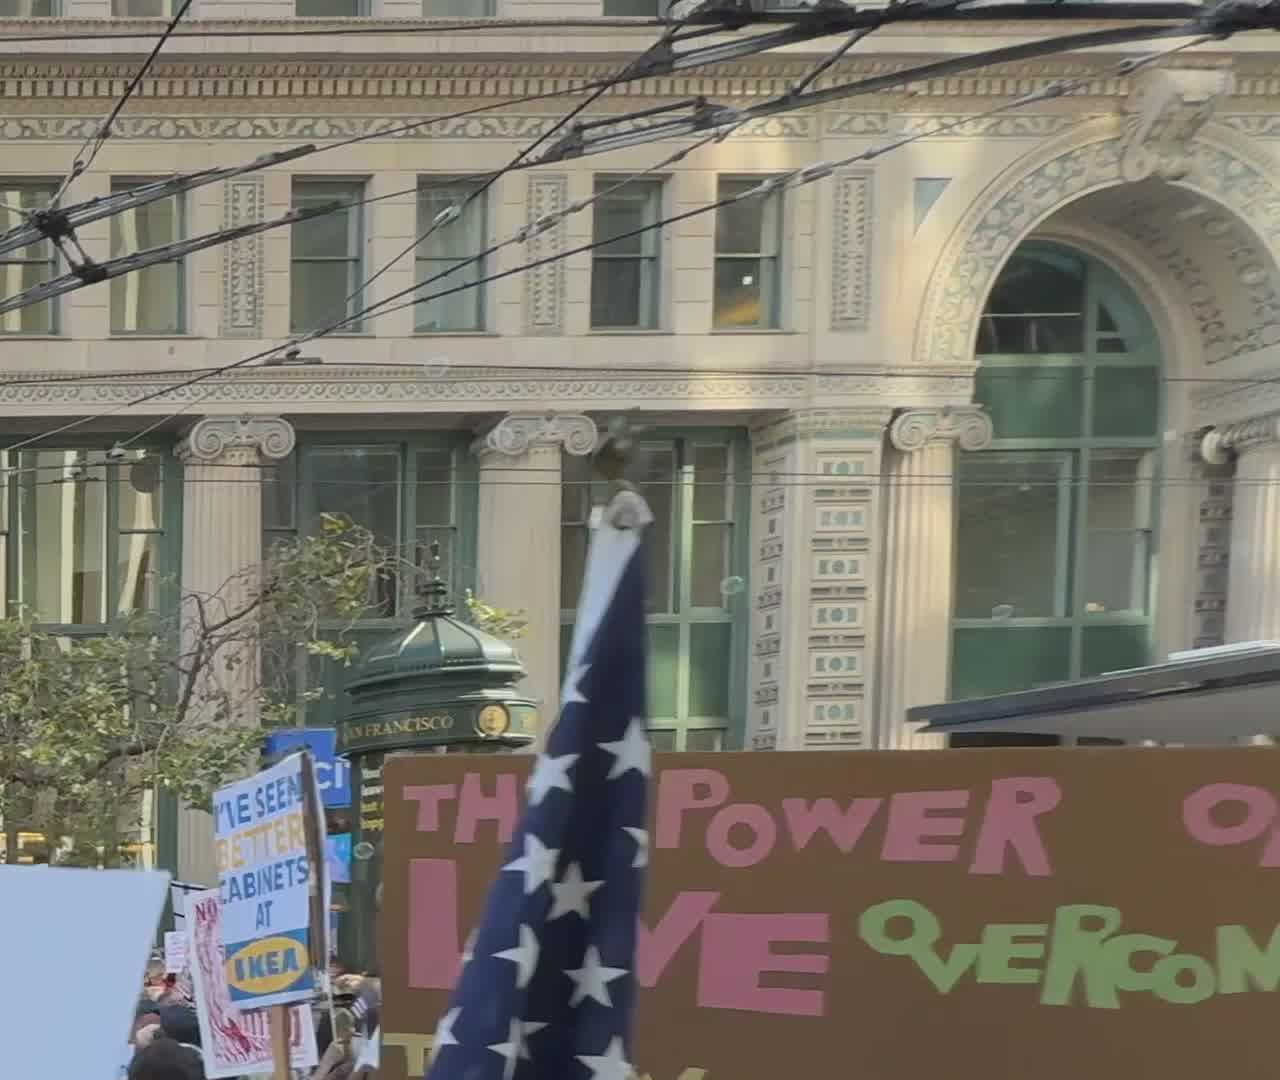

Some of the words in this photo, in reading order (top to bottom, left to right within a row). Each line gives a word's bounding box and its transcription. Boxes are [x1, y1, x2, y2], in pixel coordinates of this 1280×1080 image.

[364, 711, 455, 737] FRANCISCO
[215, 812, 305, 872] BETTER
[403, 772, 520, 844] TH
[654, 767, 1063, 876] POWER
[1182, 782, 1280, 868] O
[256, 900, 274, 930] AT
[408, 858, 830, 1016] LVE
[858, 898, 1280, 1009] OVERCOM
[235, 947, 300, 981] IKEA
